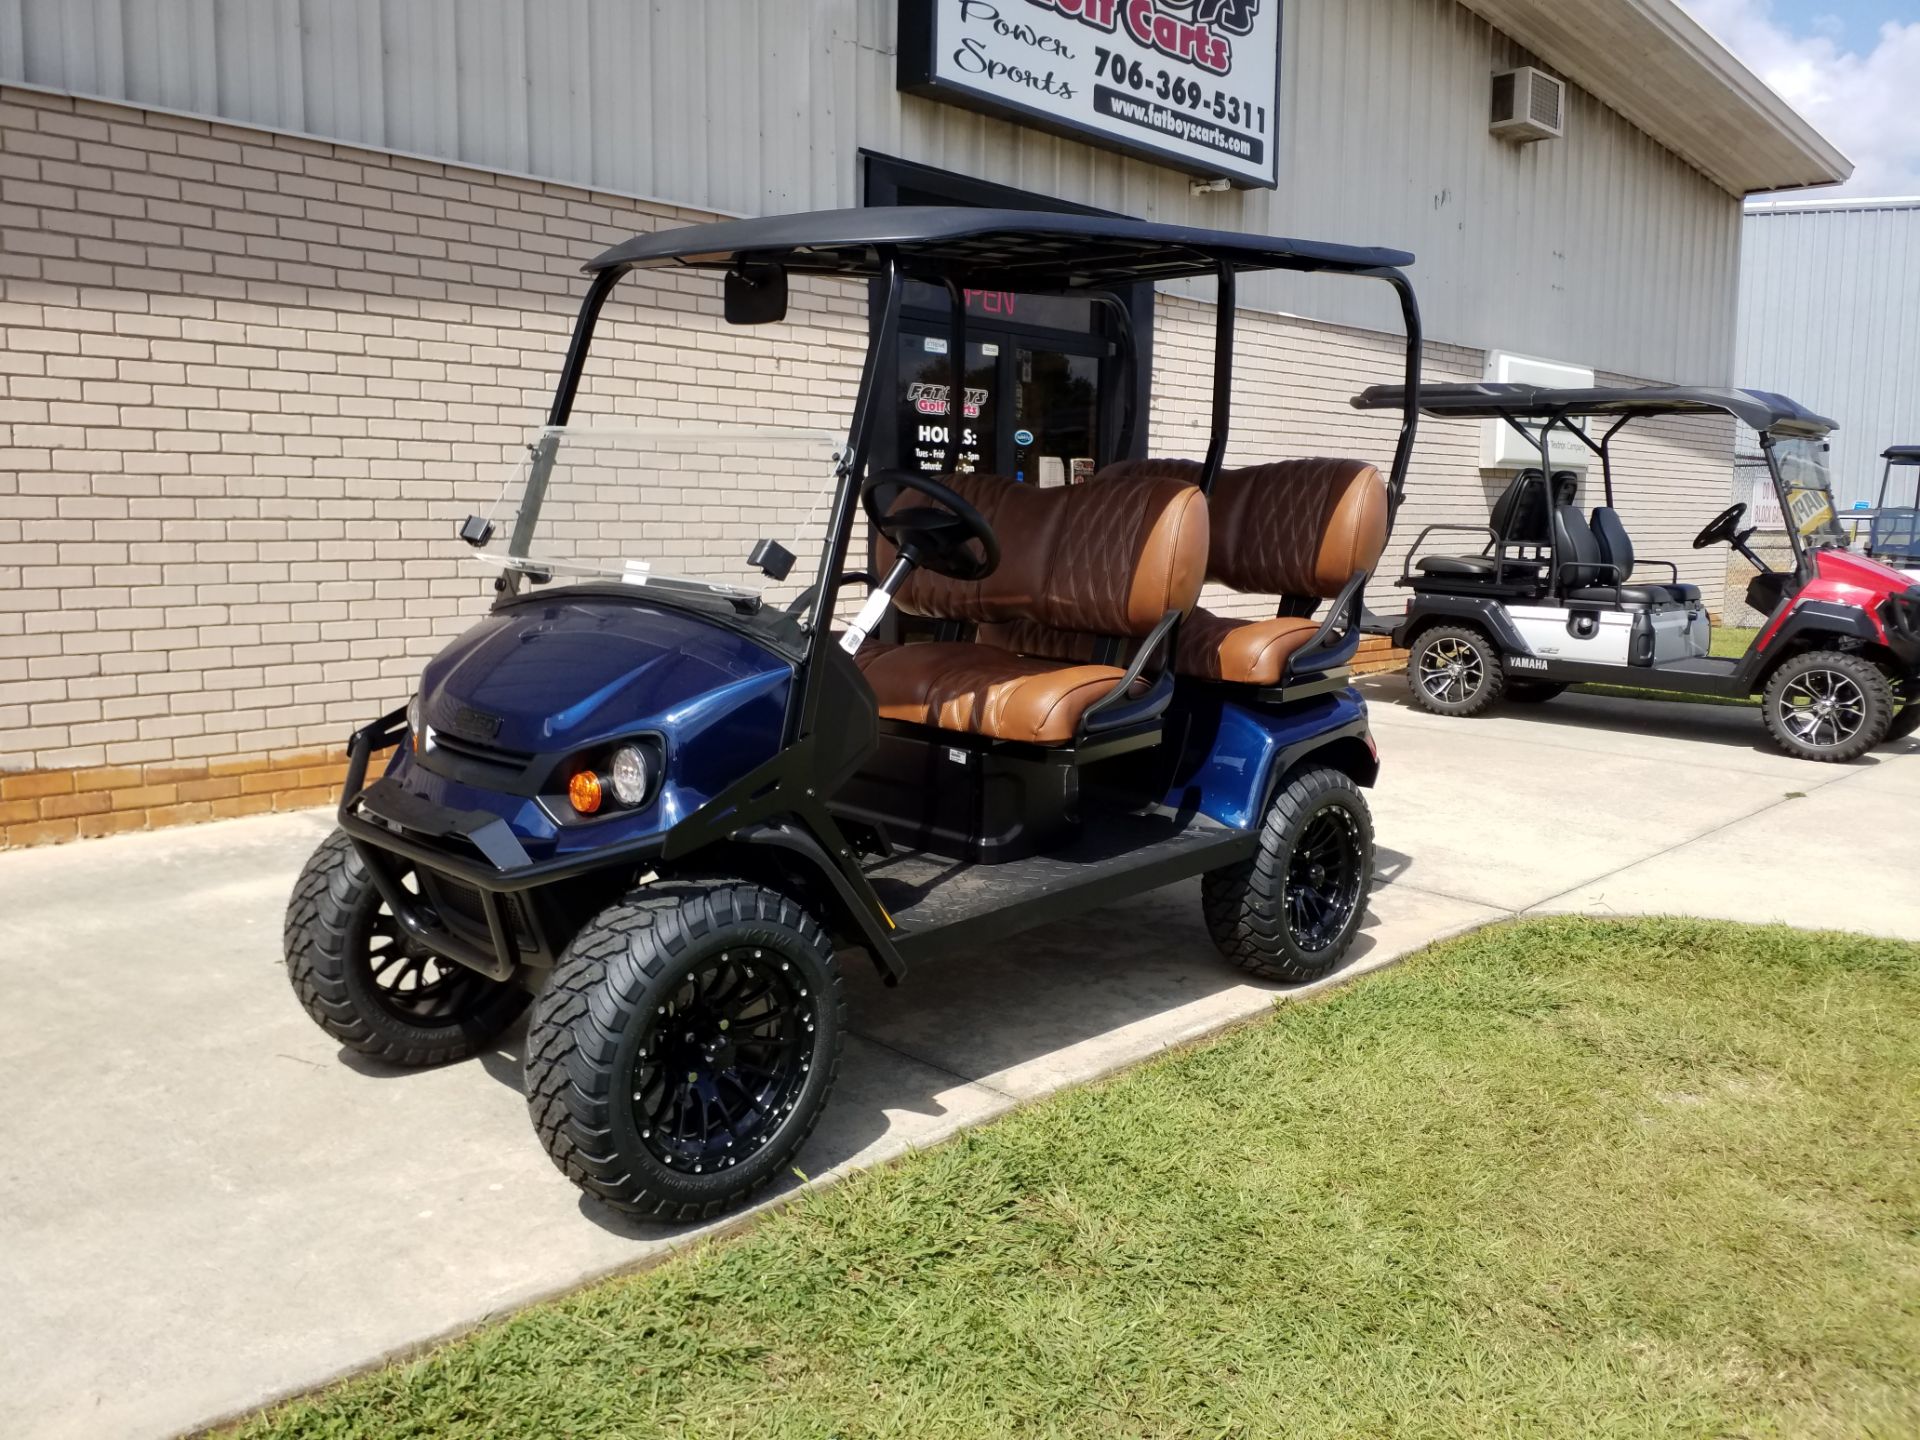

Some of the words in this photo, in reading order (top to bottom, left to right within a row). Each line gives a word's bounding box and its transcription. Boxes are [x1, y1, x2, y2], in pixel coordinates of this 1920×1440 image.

[958, 0, 1075, 59] Power
[1127, 0, 1228, 71] Carts
[953, 38, 1079, 99] Sports
[1095, 46, 1265, 134] 706-369-5311
[1111, 97, 1250, 156] www.fatboyscarts.com
[963, 289, 1015, 315] PEN
[919, 400, 945, 413] Golf
[919, 425, 977, 446] HOUS:
[920, 461, 942, 471] Saturd
[933, 449, 945, 459] Frid
[1510, 656, 1548, 670] YAMAHA
